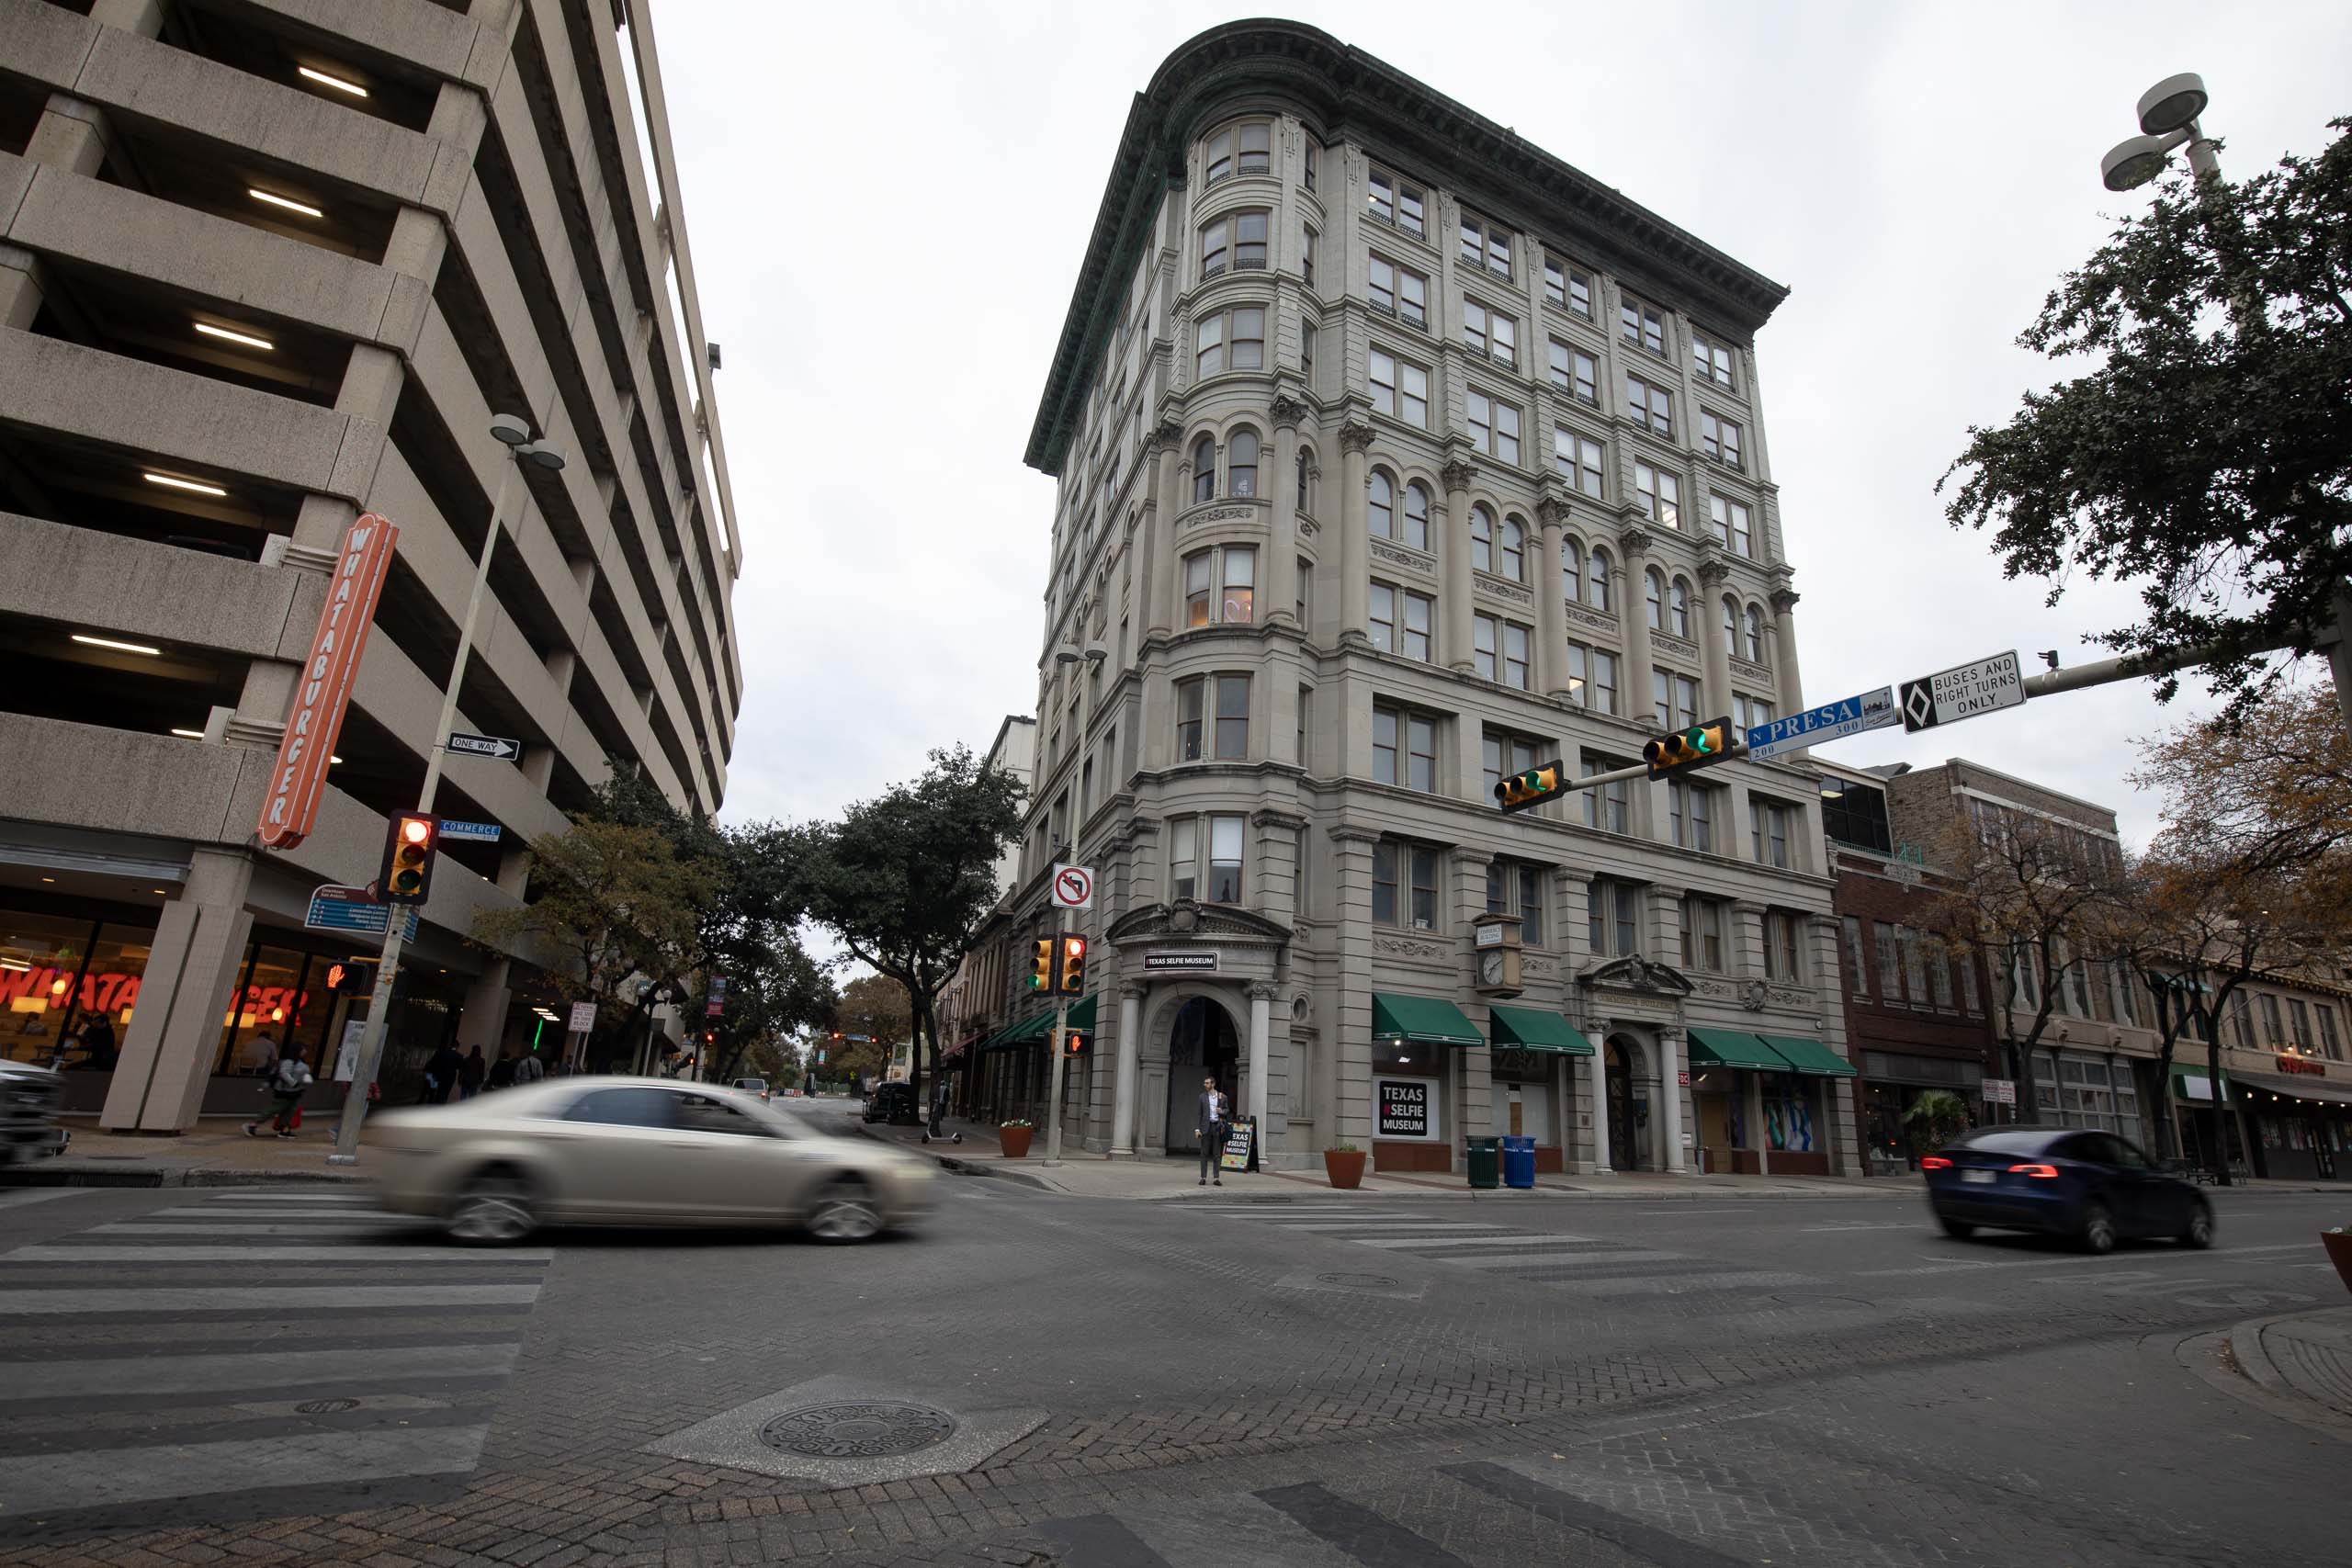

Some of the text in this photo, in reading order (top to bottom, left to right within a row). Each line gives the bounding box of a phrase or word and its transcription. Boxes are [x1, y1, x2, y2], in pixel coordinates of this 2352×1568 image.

[268, 527, 371, 825] WHATABURGER
[1935, 659, 2012, 691] BUSES AND
[1936, 672, 2016, 705] RIGHT TURNS
[1958, 693, 1996, 714] ONLY
[1753, 731, 1761, 742] N
[1770, 702, 1855, 741] PRESA
[1837, 721, 1859, 735] 300
[455, 738, 498, 751] ONE WAY
[1755, 745, 1774, 758] 200
[443, 822, 498, 835] COMMERCE
[1384, 1087, 1423, 1101] TEXAS
[1383, 1119, 1423, 1131] MUSEUM
[1232, 1133, 1249, 1141] EXAS
